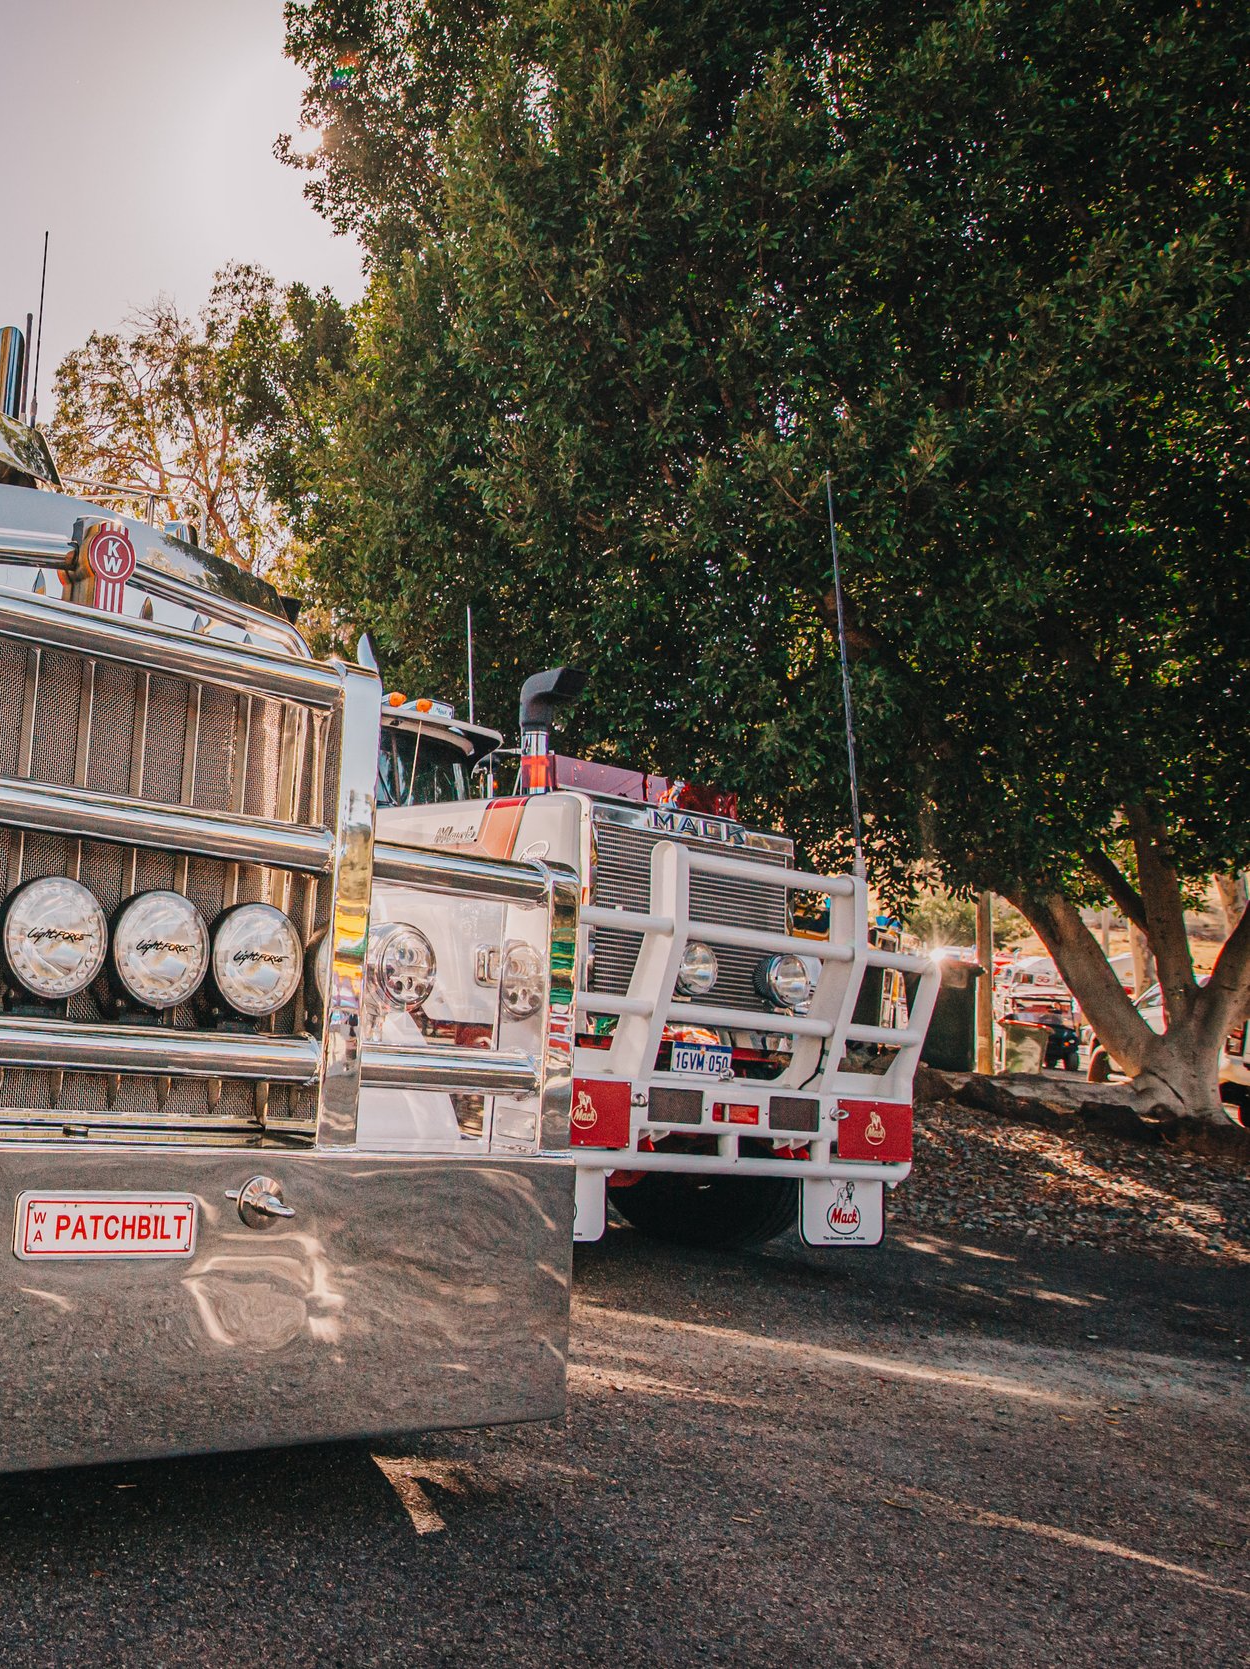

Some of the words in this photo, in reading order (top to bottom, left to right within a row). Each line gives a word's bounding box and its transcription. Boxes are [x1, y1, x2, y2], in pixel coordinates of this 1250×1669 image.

[650, 808, 746, 845] MACK
[573, 1108, 595, 1122] Mack
[830, 1207, 858, 1224] Mack
[54, 1215, 187, 1241] PATCHBILT
